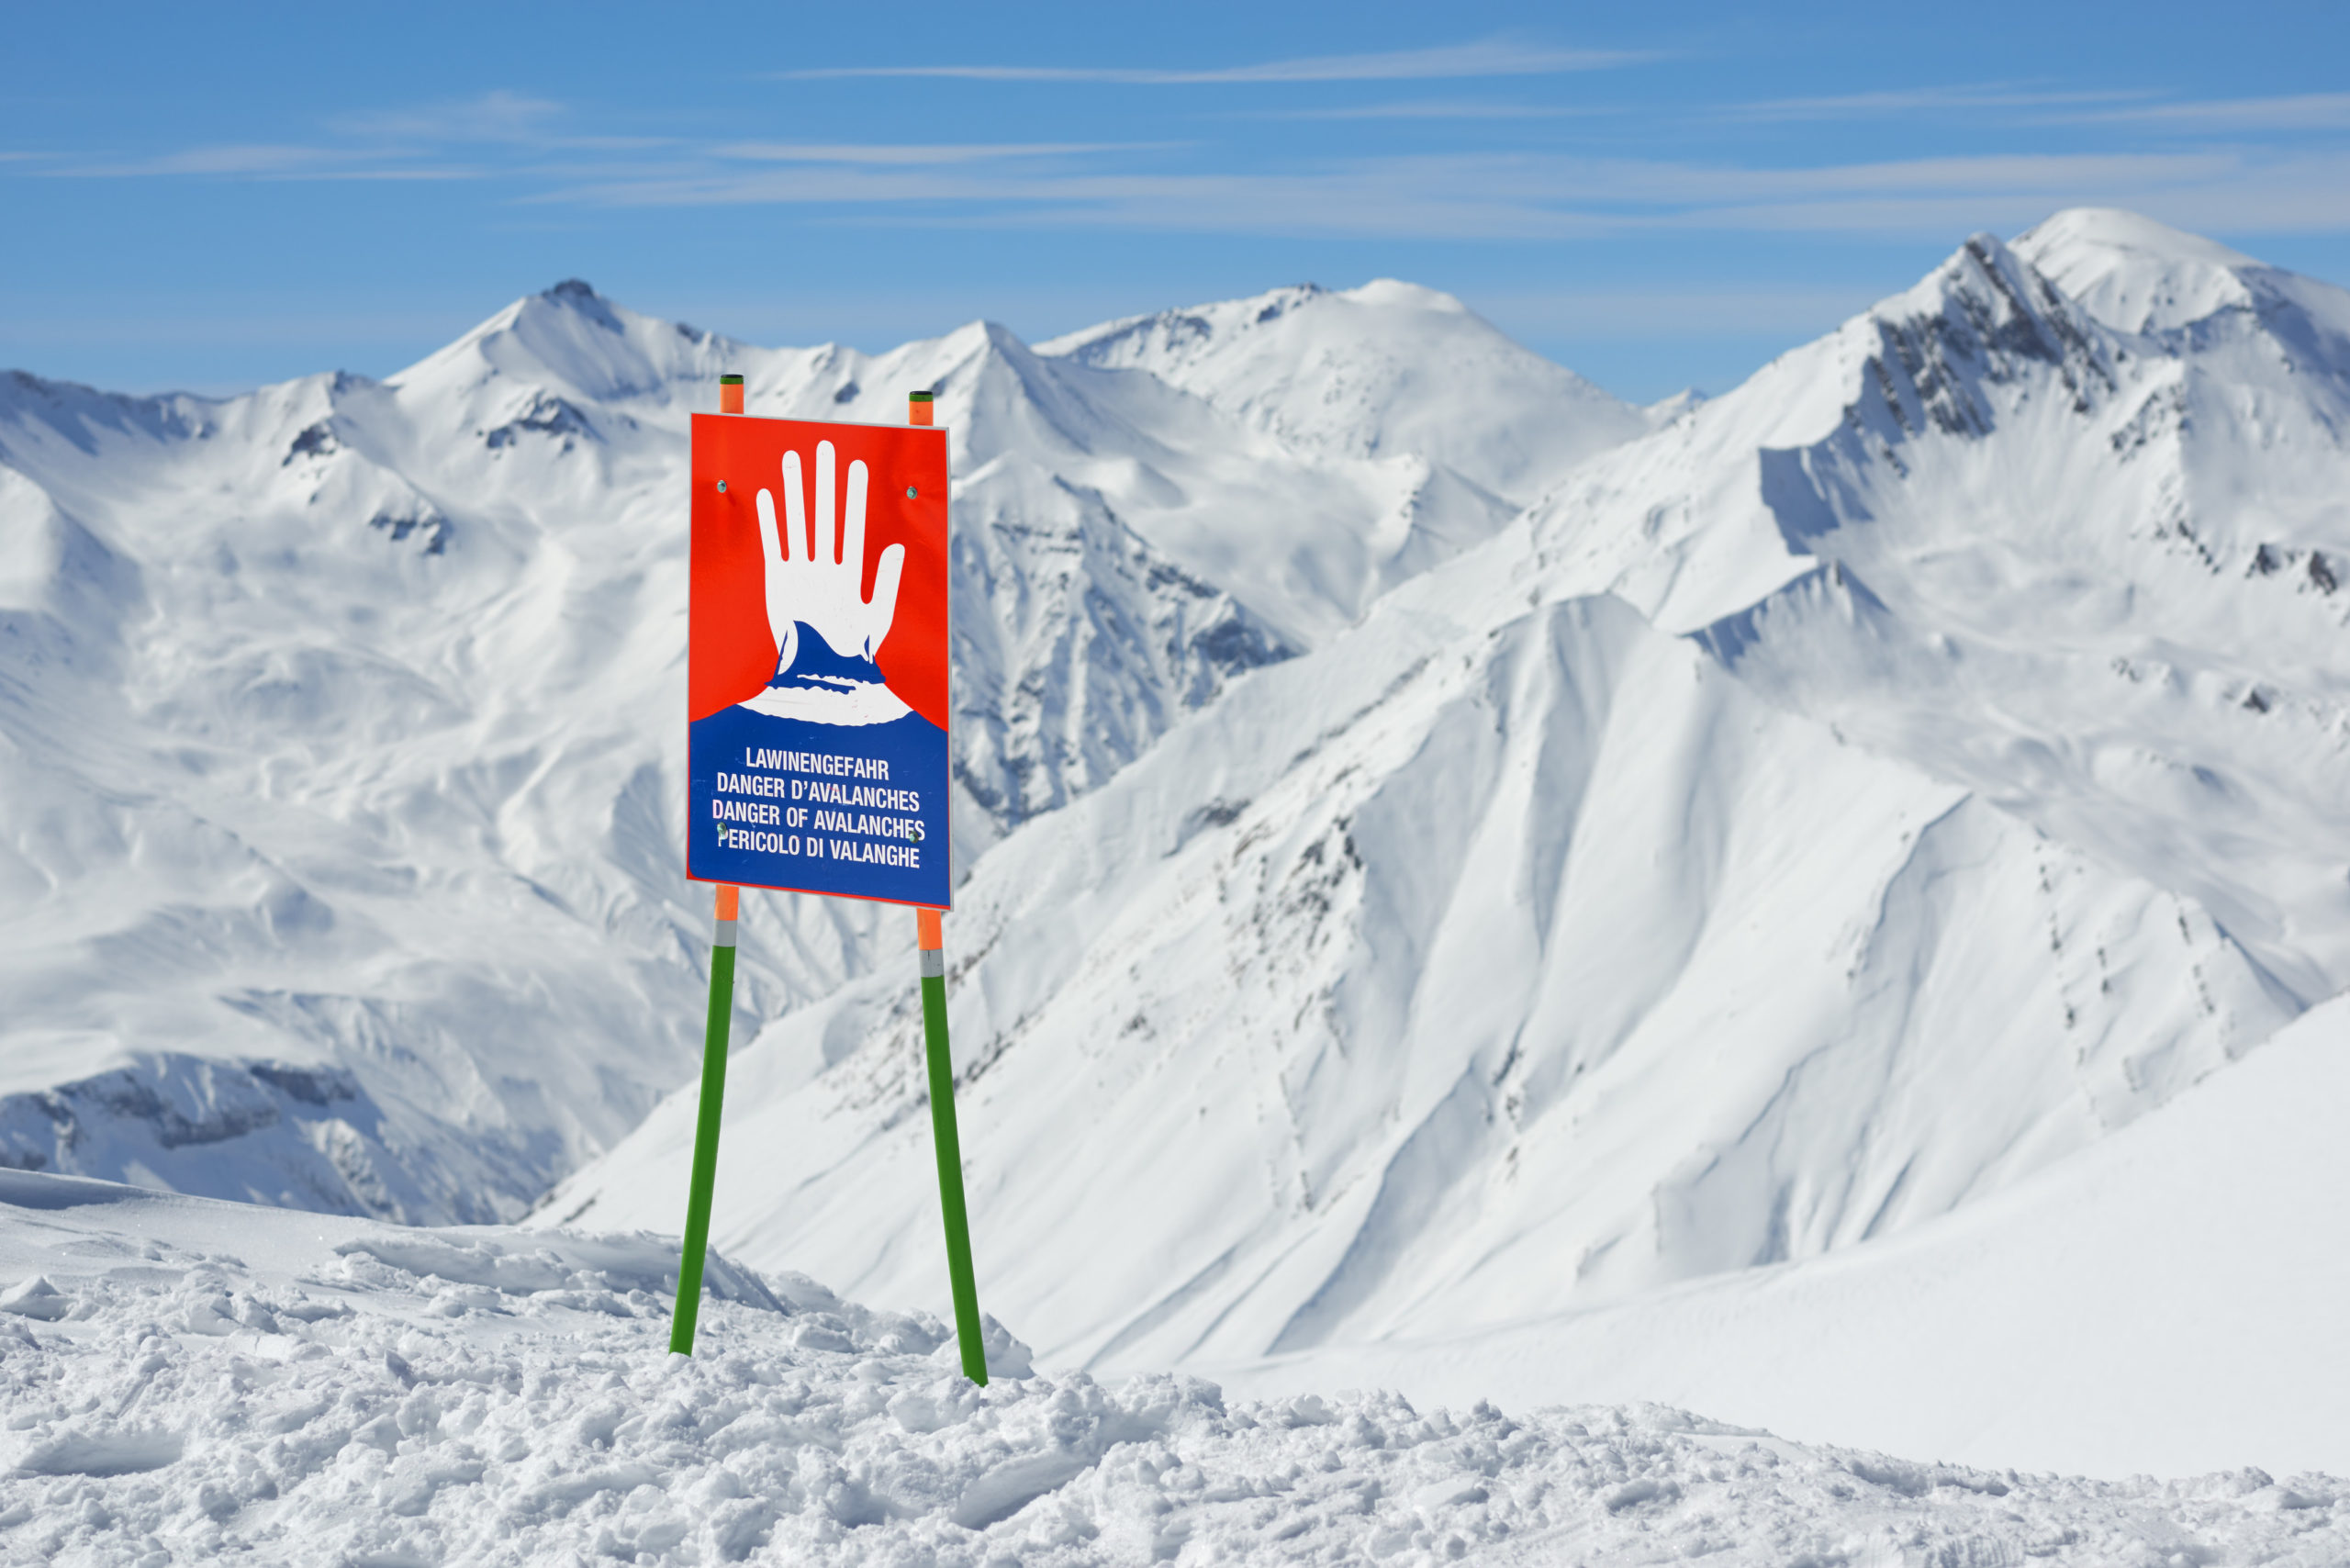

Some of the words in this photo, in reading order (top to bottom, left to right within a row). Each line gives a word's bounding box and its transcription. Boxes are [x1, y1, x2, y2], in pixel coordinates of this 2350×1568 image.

[745, 746, 890, 780] LAWINENGEFAHR
[717, 771, 785, 799] DANGER
[791, 779, 920, 812] D'AVALANCHES
[712, 799, 780, 826] DANGER
[787, 806, 809, 828] OF
[813, 811, 925, 841] AVALANCHES
[806, 836, 823, 858] DI
[830, 839, 920, 869] VALANGHE
